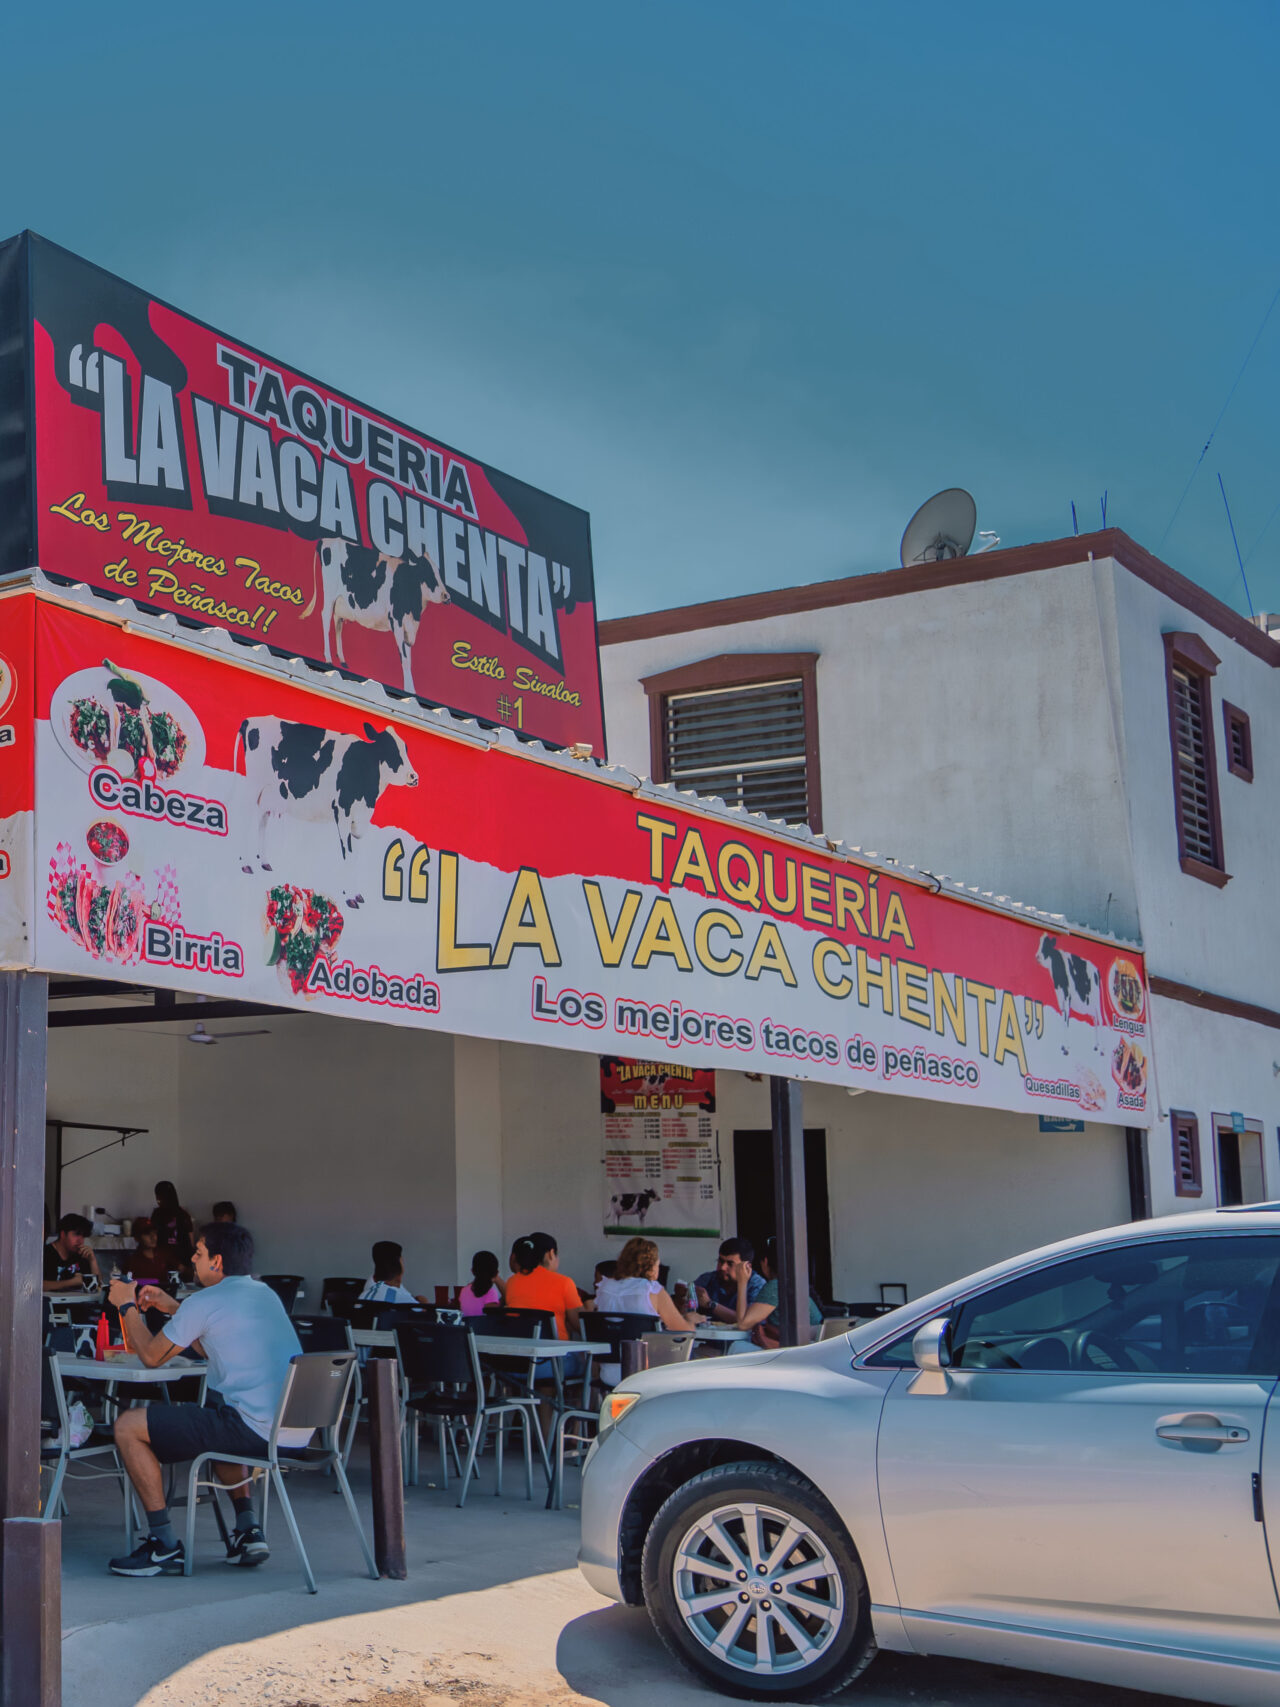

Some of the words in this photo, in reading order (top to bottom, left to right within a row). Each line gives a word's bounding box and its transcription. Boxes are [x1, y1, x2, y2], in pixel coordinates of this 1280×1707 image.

[217, 343, 478, 520] TAQUERIA
[69, 343, 186, 491] “LA
[194, 397, 359, 541] VACA
[367, 475, 571, 662] CHENTA”
[51, 493, 111, 532] Los
[116, 512, 227, 578] Mejores
[235, 559, 305, 605] Tacos
[104, 557, 138, 587] de
[148, 567, 279, 633] Peñasco!!
[451, 642, 507, 681] Estilo
[513, 666, 582, 707] Sinaloa
[496, 693, 525, 728] #1
[92, 771, 226, 830] Cabeza
[637, 812, 915, 949] TAQUERÍA
[147, 927, 241, 971] Birria
[383, 838, 562, 974] “LA
[583, 880, 798, 988] VACA
[811, 938, 1044, 1077] CHENTA”
[309, 964, 438, 1007] Adobada
[535, 982, 605, 1022] Los
[618, 1001, 754, 1048] mejores
[763, 1023, 839, 1062] tacos
[847, 1041, 876, 1067] de
[884, 1047, 979, 1086] peñasco
[1113, 1014, 1145, 1036] Lengua
[633, 1065, 657, 1078] VACA
[1025, 1077, 1080, 1099] Quesadillas
[1119, 1092, 1145, 1108] Asada
